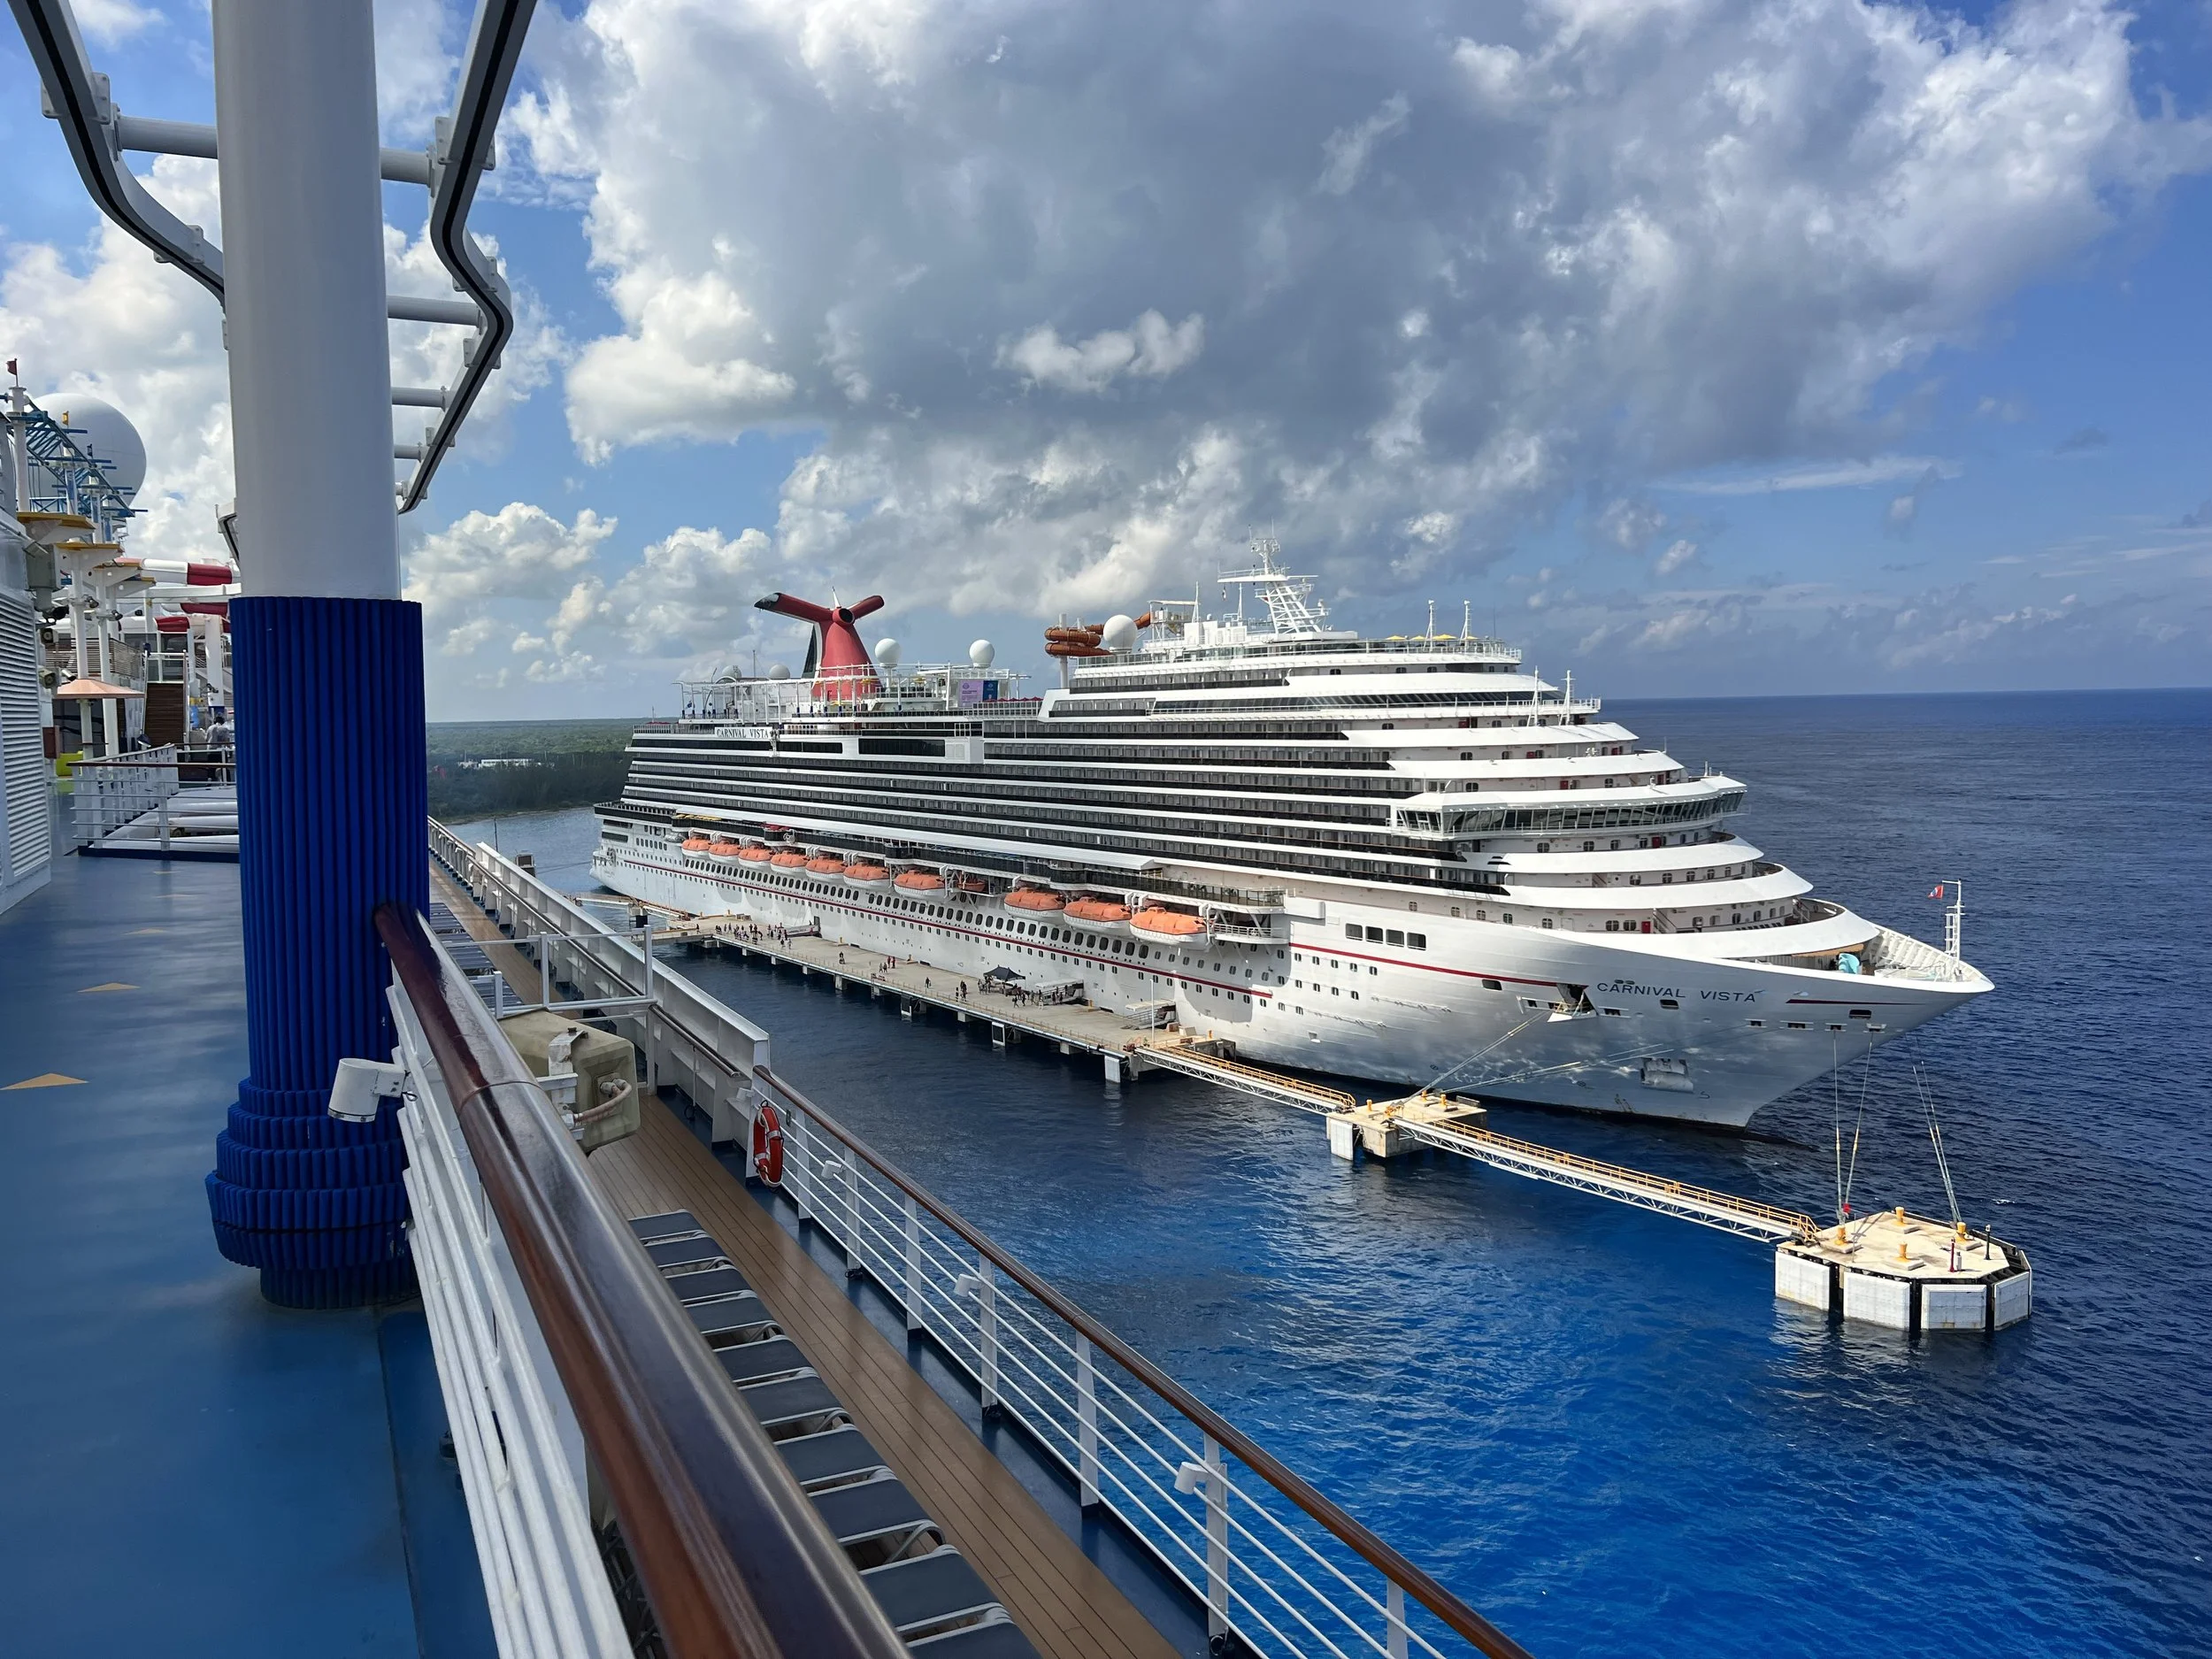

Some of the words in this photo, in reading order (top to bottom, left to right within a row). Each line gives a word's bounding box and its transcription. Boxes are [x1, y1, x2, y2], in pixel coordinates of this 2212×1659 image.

[717, 728, 747, 739] CARNIVAL
[749, 728, 769, 739] VISTA
[1596, 982, 1686, 998] CARNIVAL
[1700, 990, 1755, 1002] VISTA
